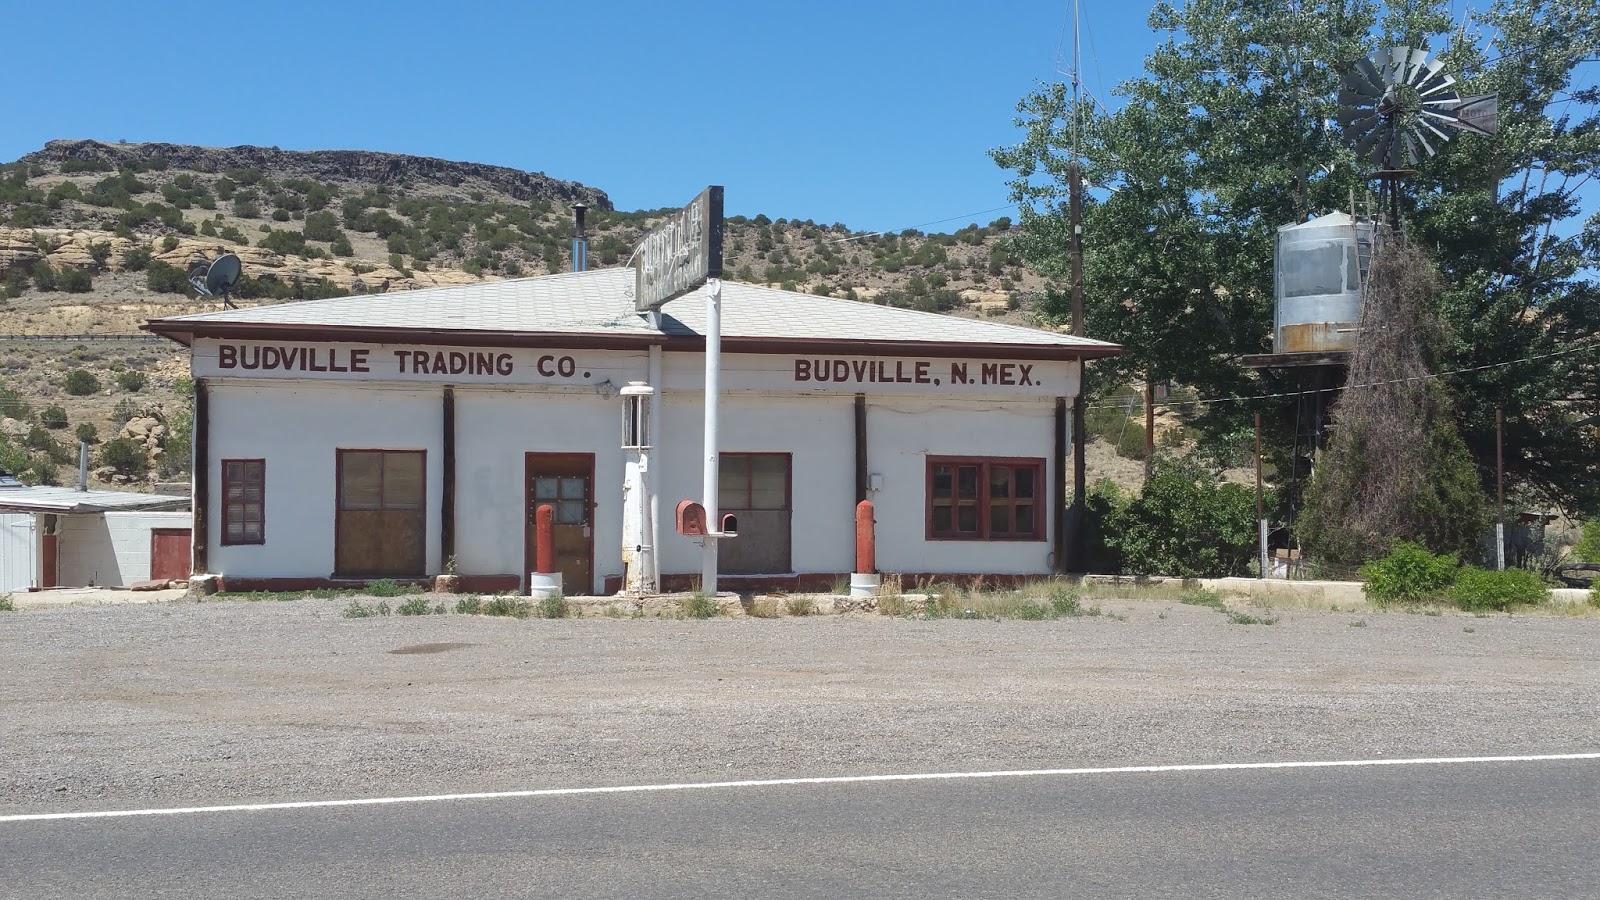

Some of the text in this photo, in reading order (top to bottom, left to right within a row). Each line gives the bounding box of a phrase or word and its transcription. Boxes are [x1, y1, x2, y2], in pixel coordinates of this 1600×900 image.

[218, 344, 592, 378] BUDVILLE TRADING CO.
[794, 359, 941, 387] BUDVILLE,
